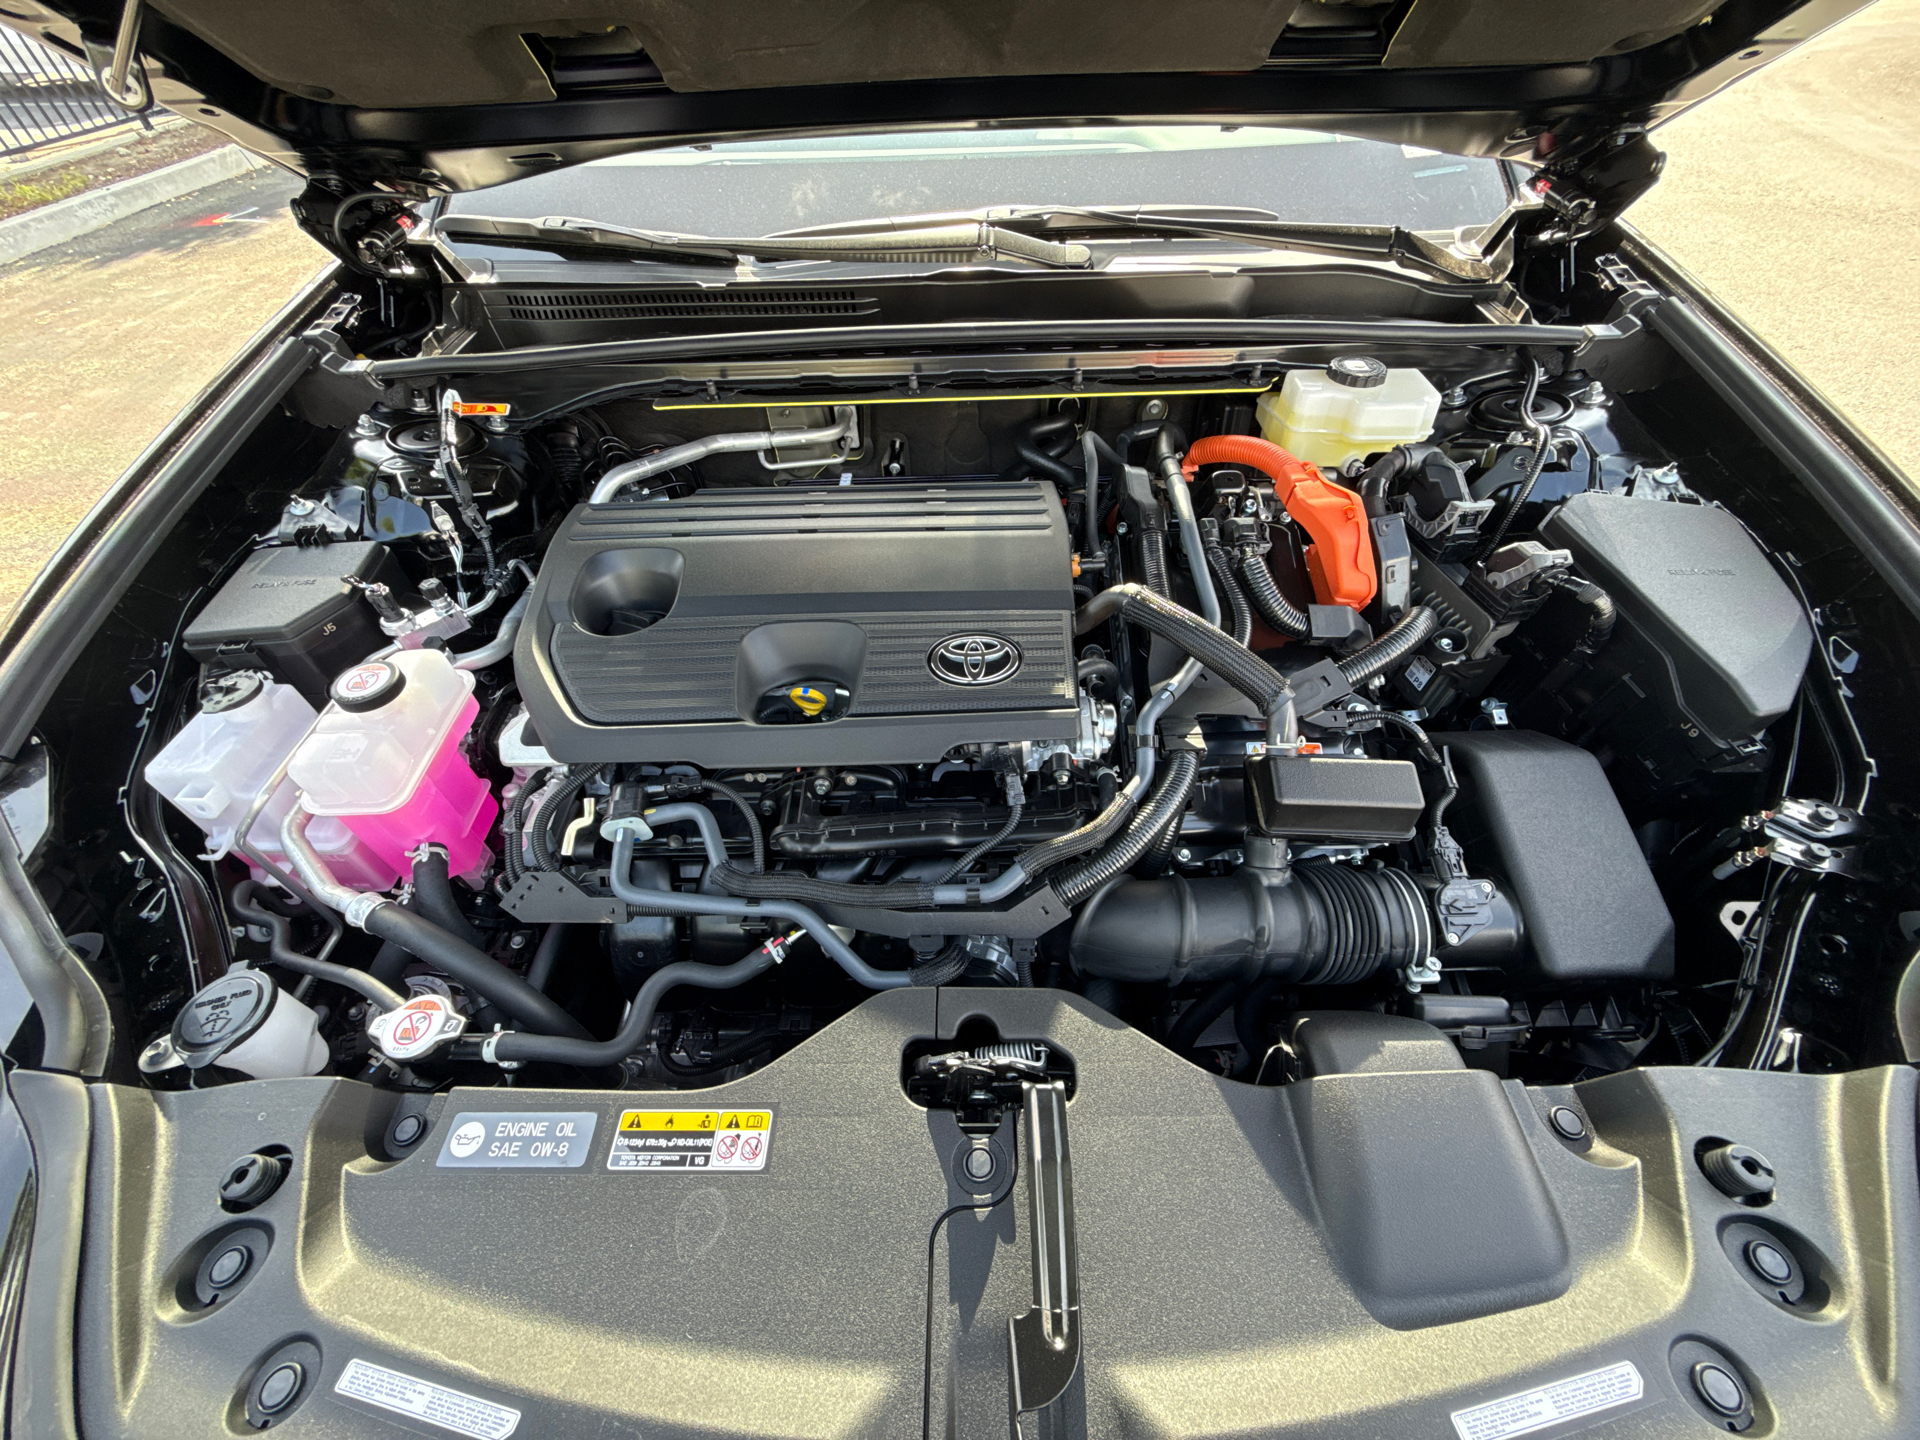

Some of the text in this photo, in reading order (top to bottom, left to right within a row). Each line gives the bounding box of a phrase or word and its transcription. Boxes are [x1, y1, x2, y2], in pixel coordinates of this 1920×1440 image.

[322, 622, 336, 635] J5
[1412, 676, 1424, 689] P8
[1680, 722, 1699, 737] J9
[230, 989, 252, 999] FLUID
[494, 1122, 577, 1137] ENGINE OIL
[488, 1141, 569, 1157] SAE 0W-8
[694, 1156, 705, 1165] VG
